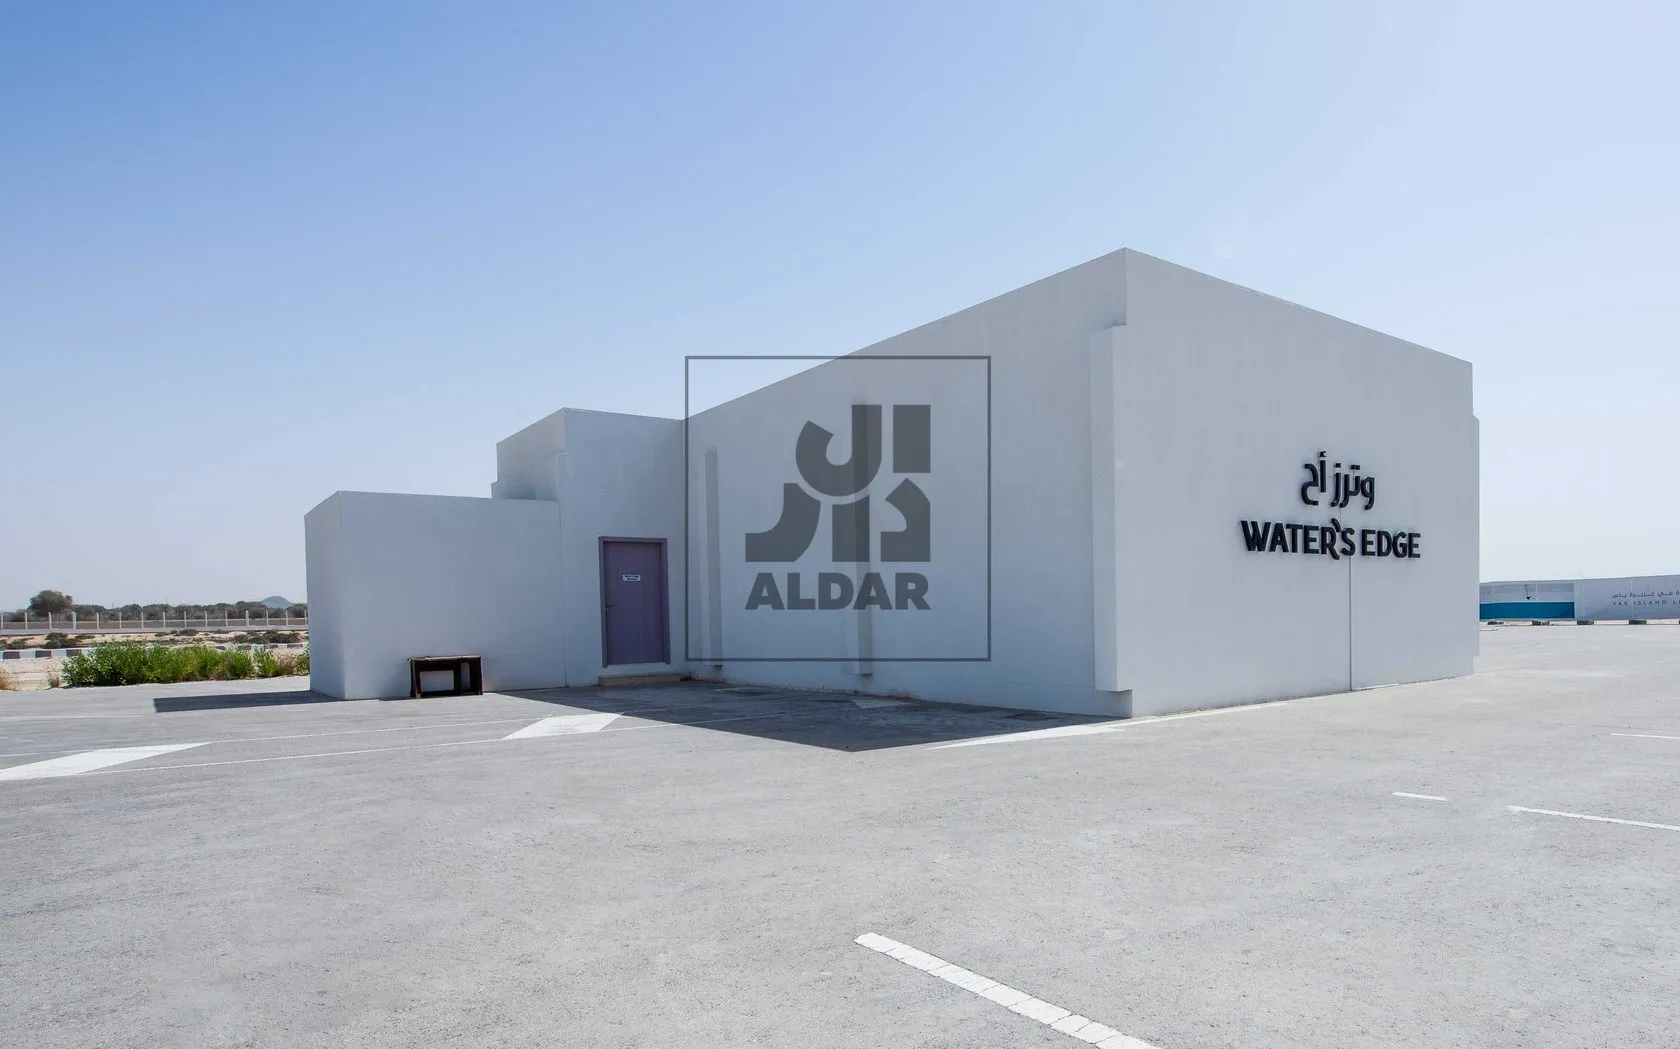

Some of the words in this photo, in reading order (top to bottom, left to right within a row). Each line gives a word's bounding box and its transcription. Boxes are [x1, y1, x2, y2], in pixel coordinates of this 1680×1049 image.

[1330, 462, 1375, 510] وترز
[1241, 518, 1356, 560] WATER'S
[1361, 529, 1421, 558] EDGE
